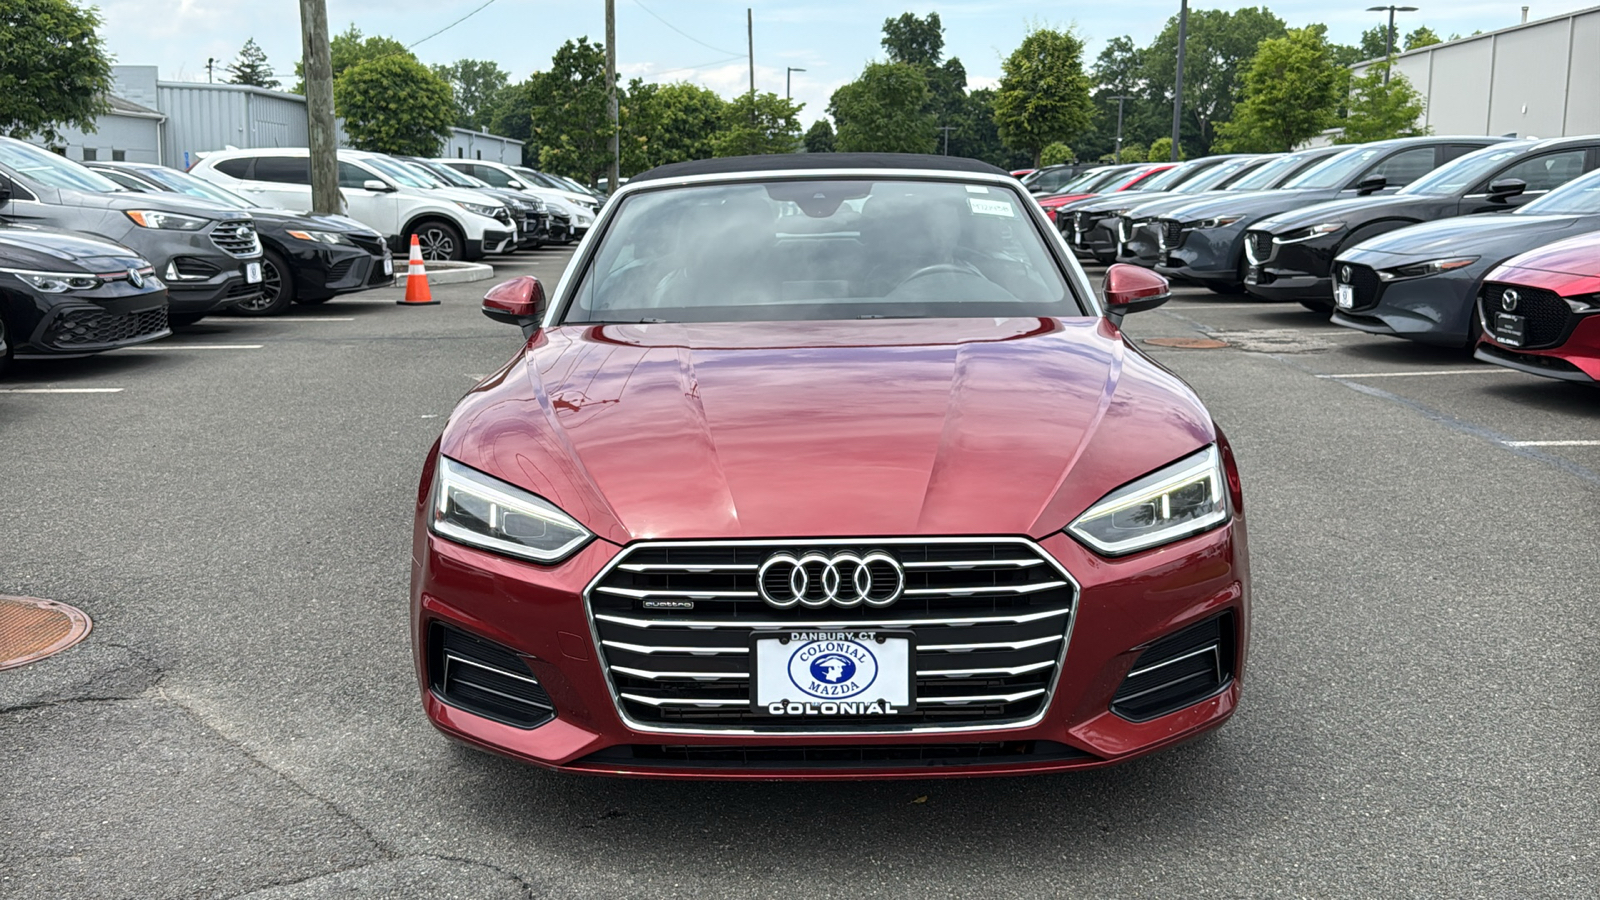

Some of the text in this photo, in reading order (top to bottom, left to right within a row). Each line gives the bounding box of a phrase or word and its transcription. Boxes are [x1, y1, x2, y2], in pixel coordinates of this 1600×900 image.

[791, 632, 876, 641] DANBURY, CT
[800, 642, 866, 663] COLONIAL
[808, 681, 859, 695] MAZDA
[769, 702, 898, 715] COLONIAL
